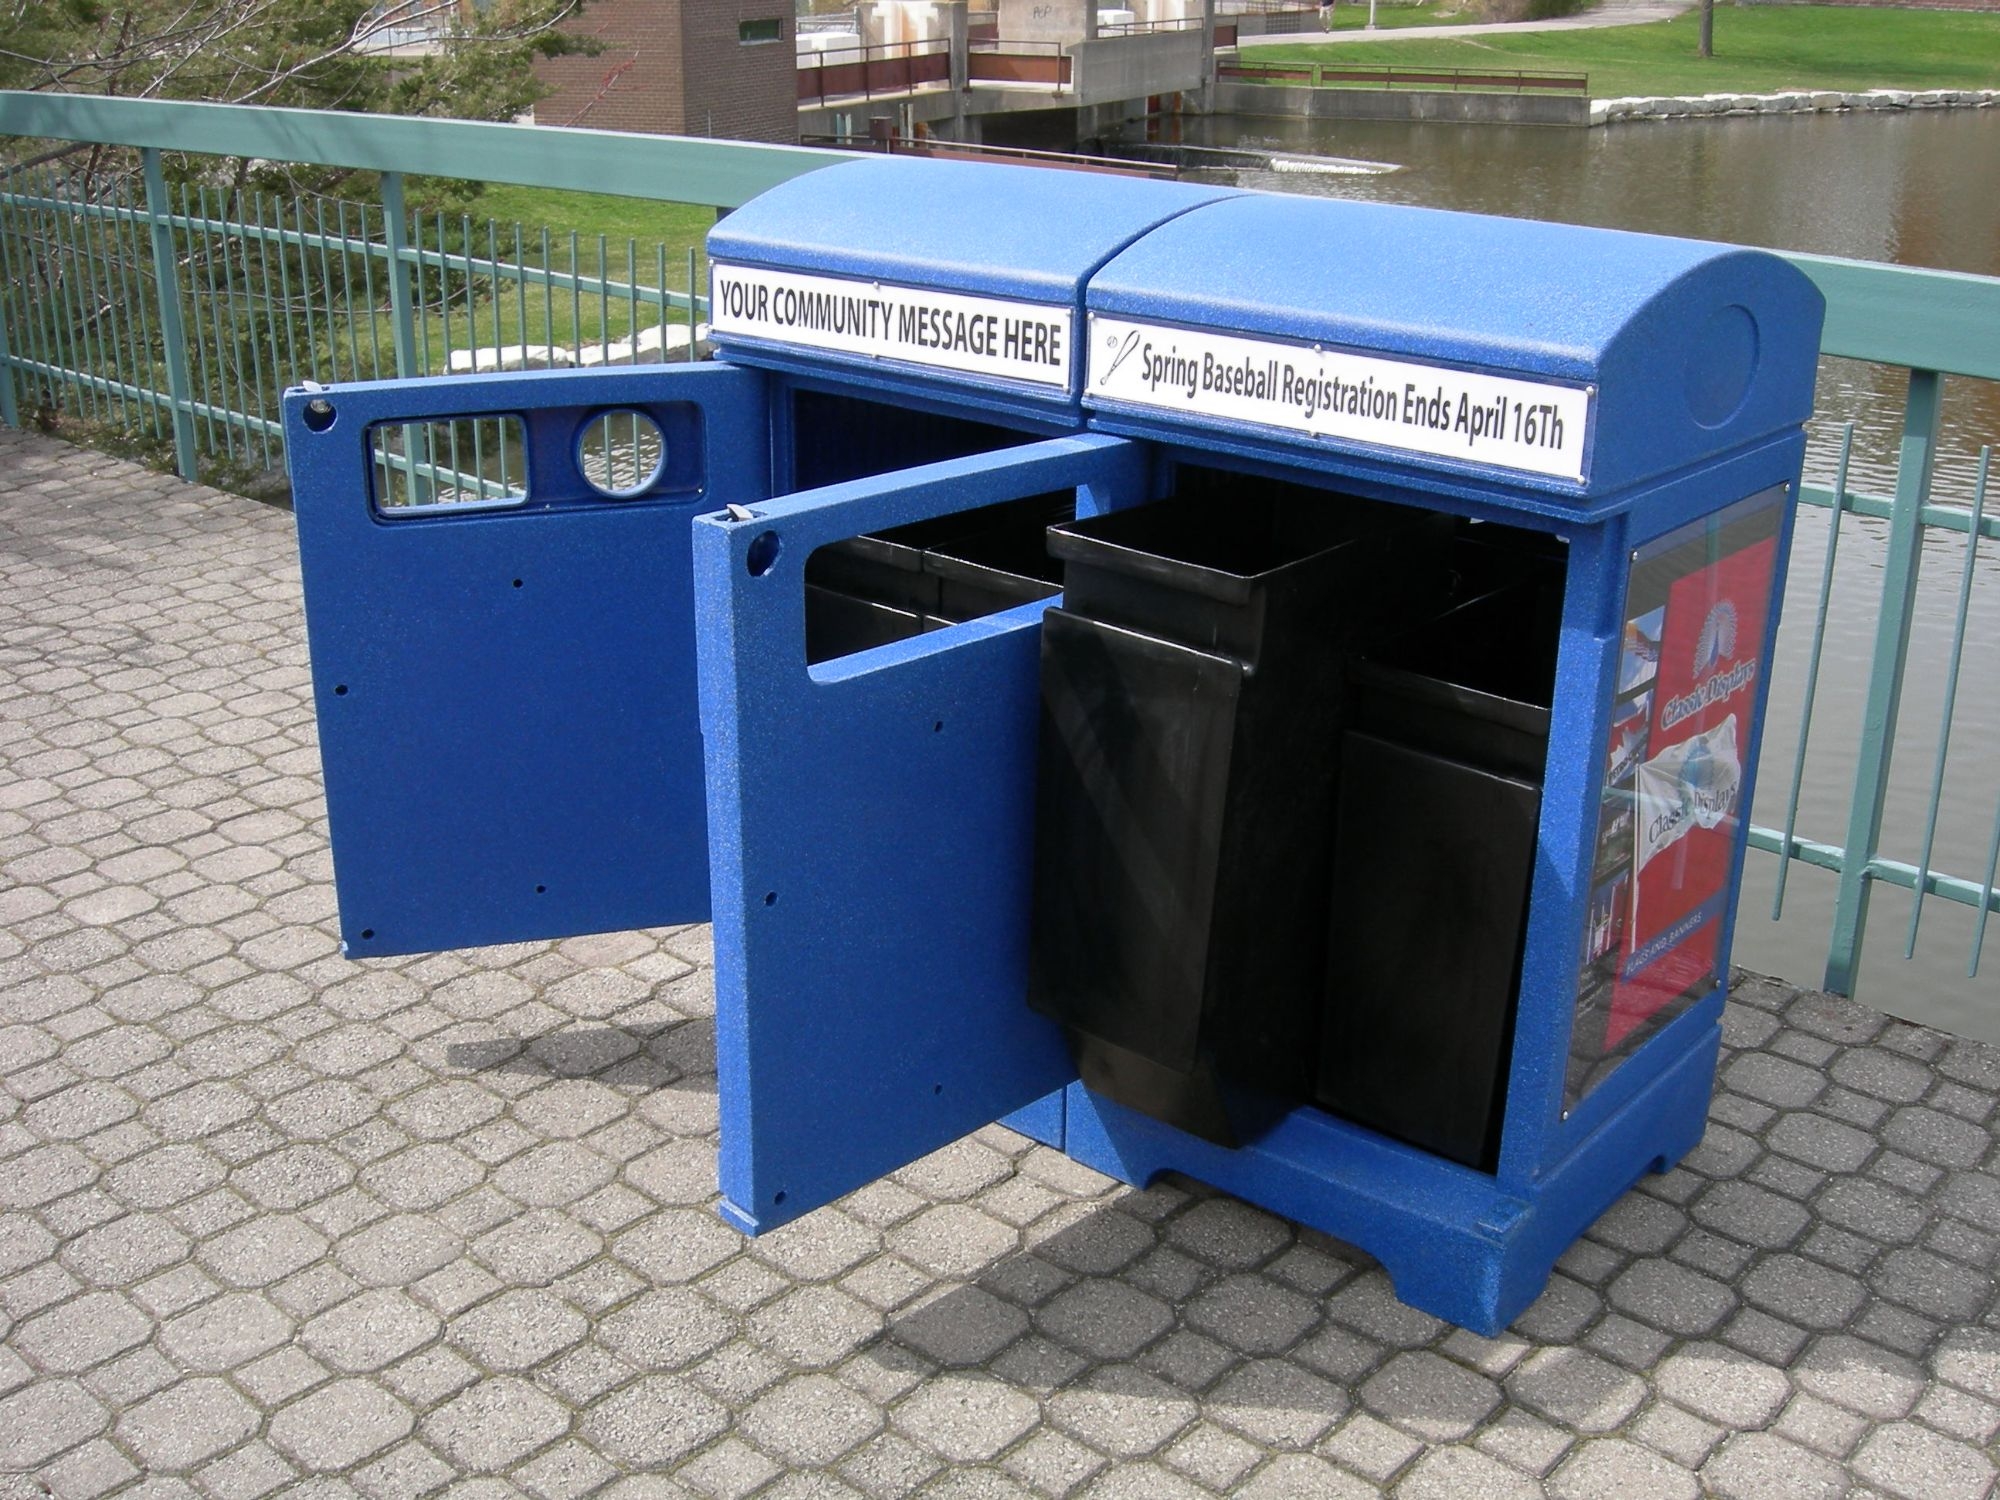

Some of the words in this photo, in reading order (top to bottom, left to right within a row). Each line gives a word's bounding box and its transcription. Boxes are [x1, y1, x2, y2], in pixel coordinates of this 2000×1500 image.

[720, 280, 768, 321] YOUR
[773, 287, 892, 340] COMMUNITY
[899, 304, 997, 356] MESSAGE
[1005, 316, 1061, 366] HERE
[1141, 343, 1197, 398] Spring
[1203, 356, 1276, 402] Baseball
[1282, 366, 1396, 424] Registration
[1403, 383, 1450, 430] Ends
[1455, 392, 1506, 445] April
[1514, 402, 1564, 450] 16Th
[1661, 684, 1706, 731] Classic
[1706, 658, 1756, 702] Displays
[1694, 781, 1738, 819] Displays
